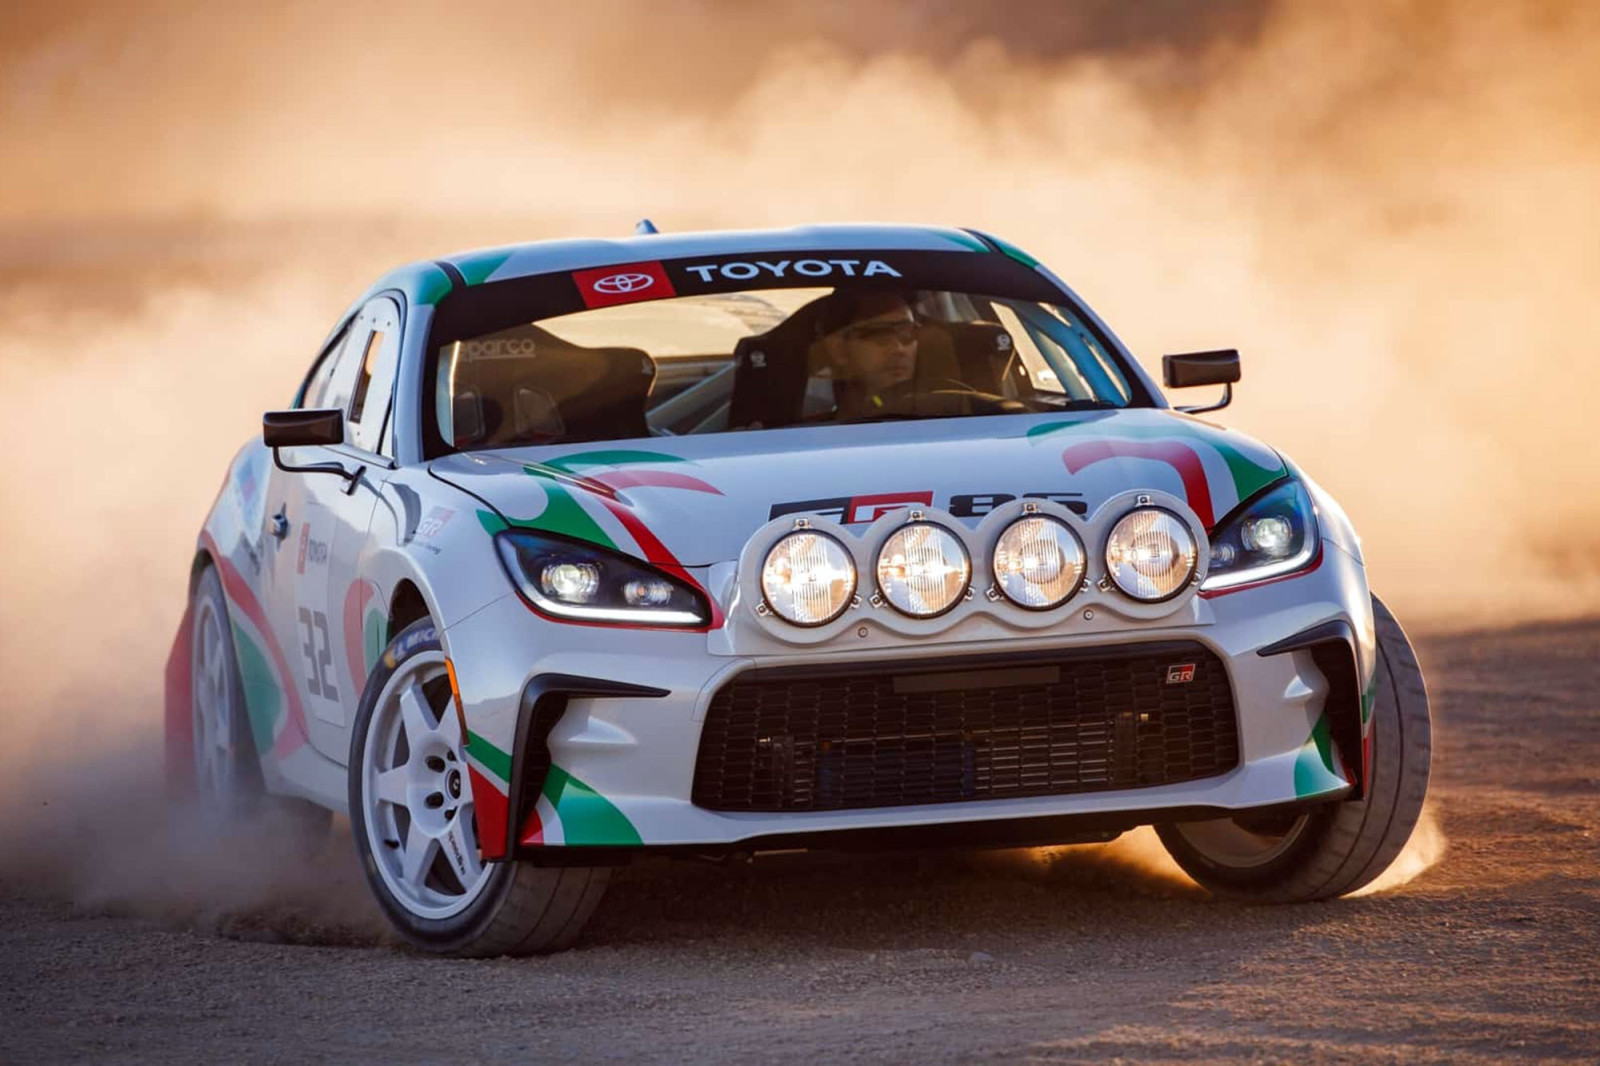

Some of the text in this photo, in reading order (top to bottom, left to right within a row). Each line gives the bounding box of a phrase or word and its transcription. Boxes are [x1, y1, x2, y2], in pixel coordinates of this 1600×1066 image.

[686, 259, 902, 282] TOYOTA
[299, 607, 339, 702] 32
[1169, 670, 1194, 682] GR
